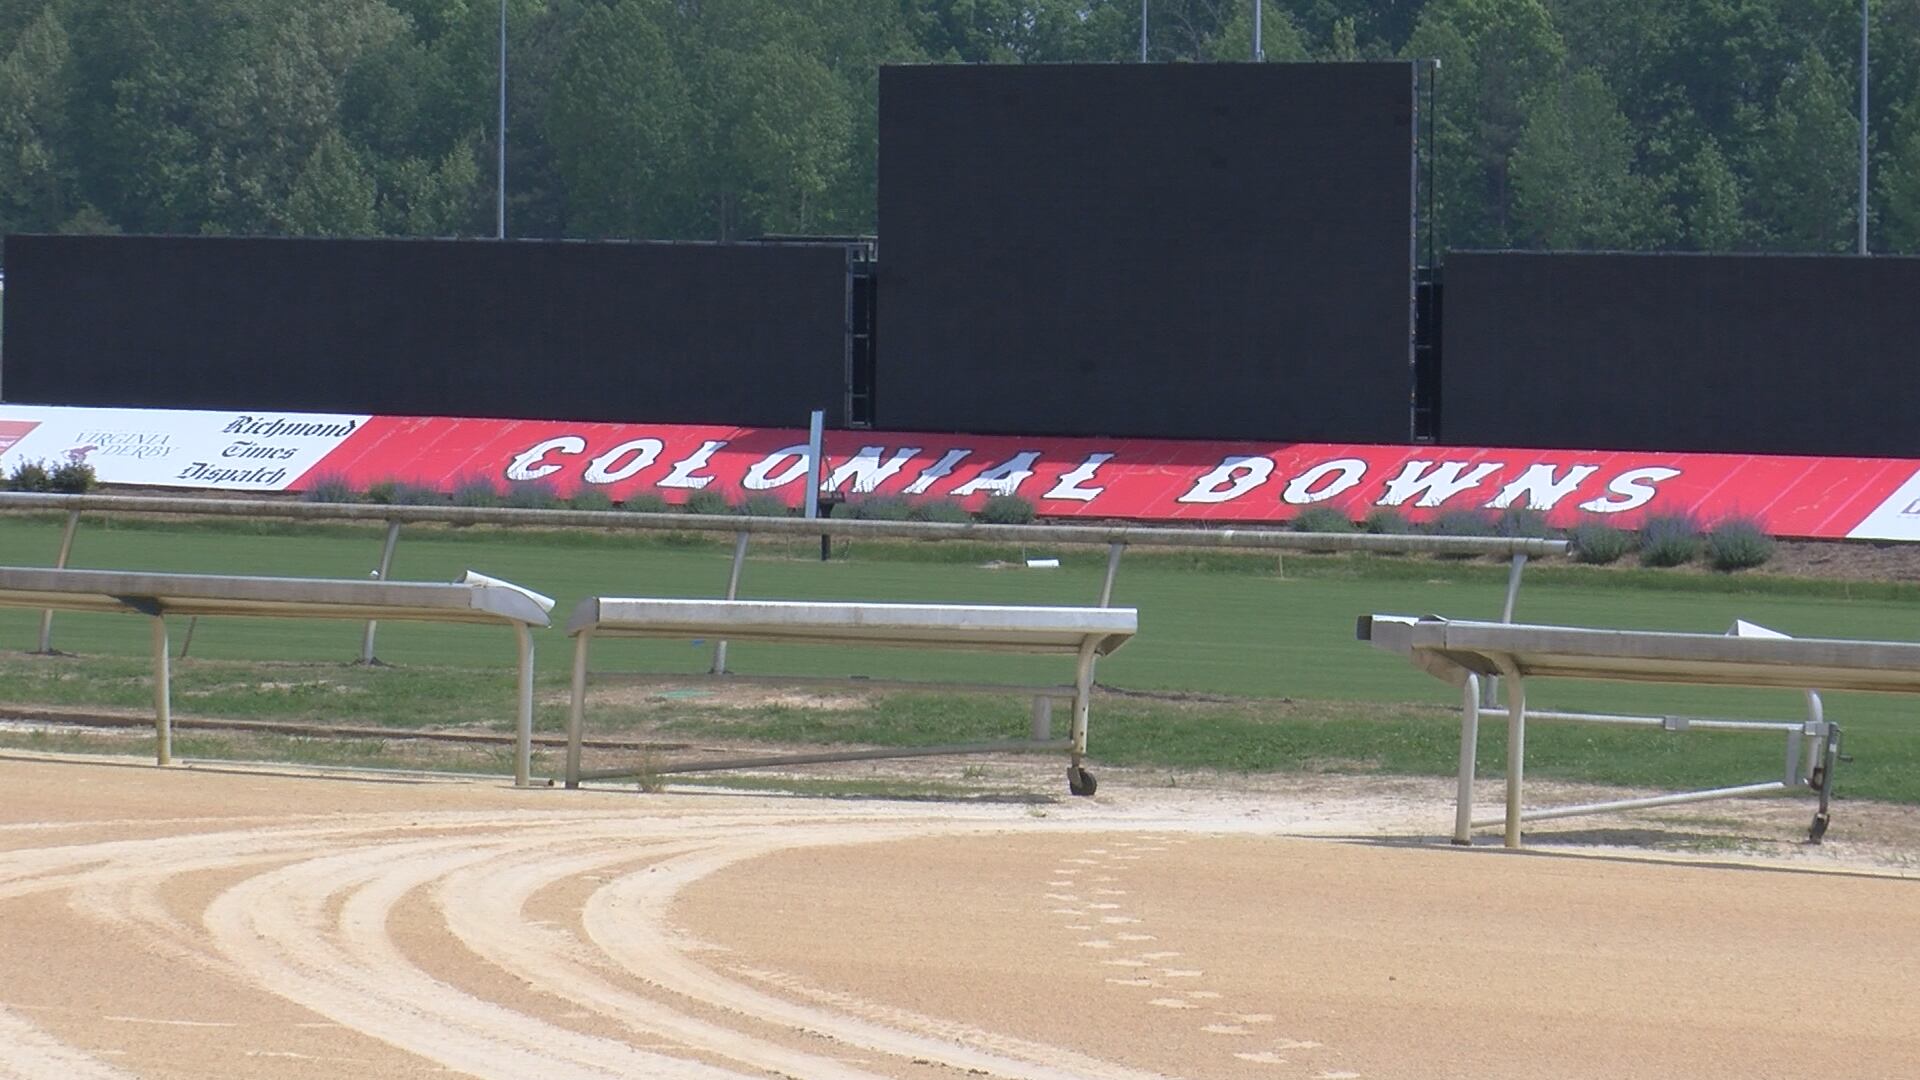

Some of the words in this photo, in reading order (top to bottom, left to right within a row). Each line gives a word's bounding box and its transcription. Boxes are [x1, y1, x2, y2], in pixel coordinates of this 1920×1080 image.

[222, 416, 356, 438] Richmond
[74, 432, 170, 446] VIRGINIA
[102, 445, 177, 459] DERBY
[222, 441, 298, 460] Times
[177, 462, 286, 486] Dispatch
[506, 435, 1115, 502] COLONIAL
[1175, 456, 1682, 513] DOWNS
